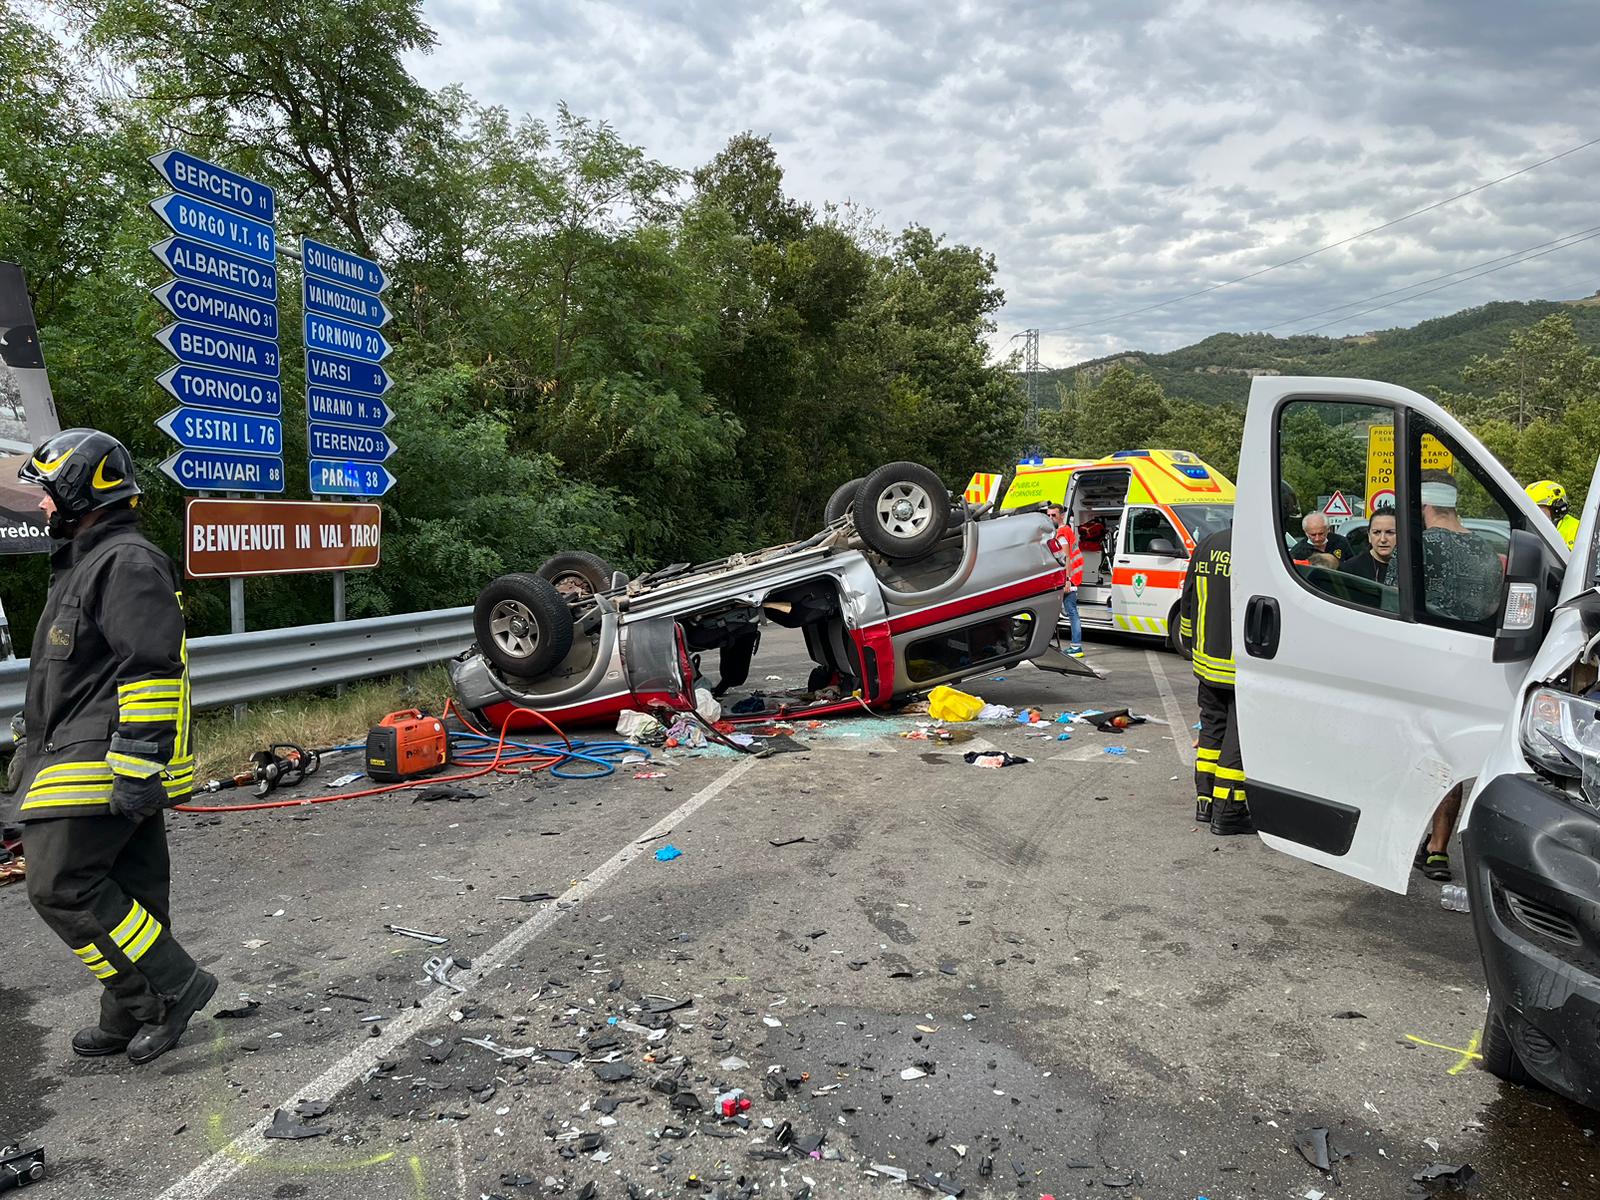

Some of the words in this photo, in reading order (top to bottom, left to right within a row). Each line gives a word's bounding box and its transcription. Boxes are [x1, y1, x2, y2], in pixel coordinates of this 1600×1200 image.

[175, 160, 252, 206] BERCETO
[259, 196, 267, 209] 11
[180, 205, 224, 237] BORGO
[230, 219, 252, 246] V.T.
[256, 231, 269, 252] 16
[173, 247, 259, 287] ALBARETO
[262, 275, 272, 289] 24
[308, 248, 363, 281] SOLIGNANO
[175, 290, 261, 326] COMPIANO
[263, 316, 272, 327] 31
[309, 285, 367, 317] VALMOZZOLA
[371, 306, 378, 318] 17
[180, 333, 257, 365] BEDONIA
[265, 352, 275, 366] 32
[311, 322, 362, 350] FORNOVO
[366, 336, 378, 354] 20
[312, 359, 351, 382] VARSI
[373, 374, 382, 386] 28
[181, 375, 262, 404] TORNOLO
[266, 390, 277, 404] 34
[312, 395, 353, 417] VARANO
[358, 402, 369, 419] M.
[373, 407, 381, 419] 29
[185, 417, 237, 442] SESTRI
[244, 423, 254, 444] L.
[259, 426, 275, 446] 76
[314, 432, 374, 453] TERENZO
[375, 441, 384, 452] 33
[181, 459, 260, 482] CHIAVARI
[269, 468, 280, 481] 88
[322, 468, 359, 487] PARMA
[366, 471, 378, 488] 38
[193, 525, 285, 552] BENVENUTI
[295, 525, 311, 549] IN
[319, 525, 344, 548] VAL
[350, 525, 378, 547] TARO
[1210, 550, 1232, 565] VIG
